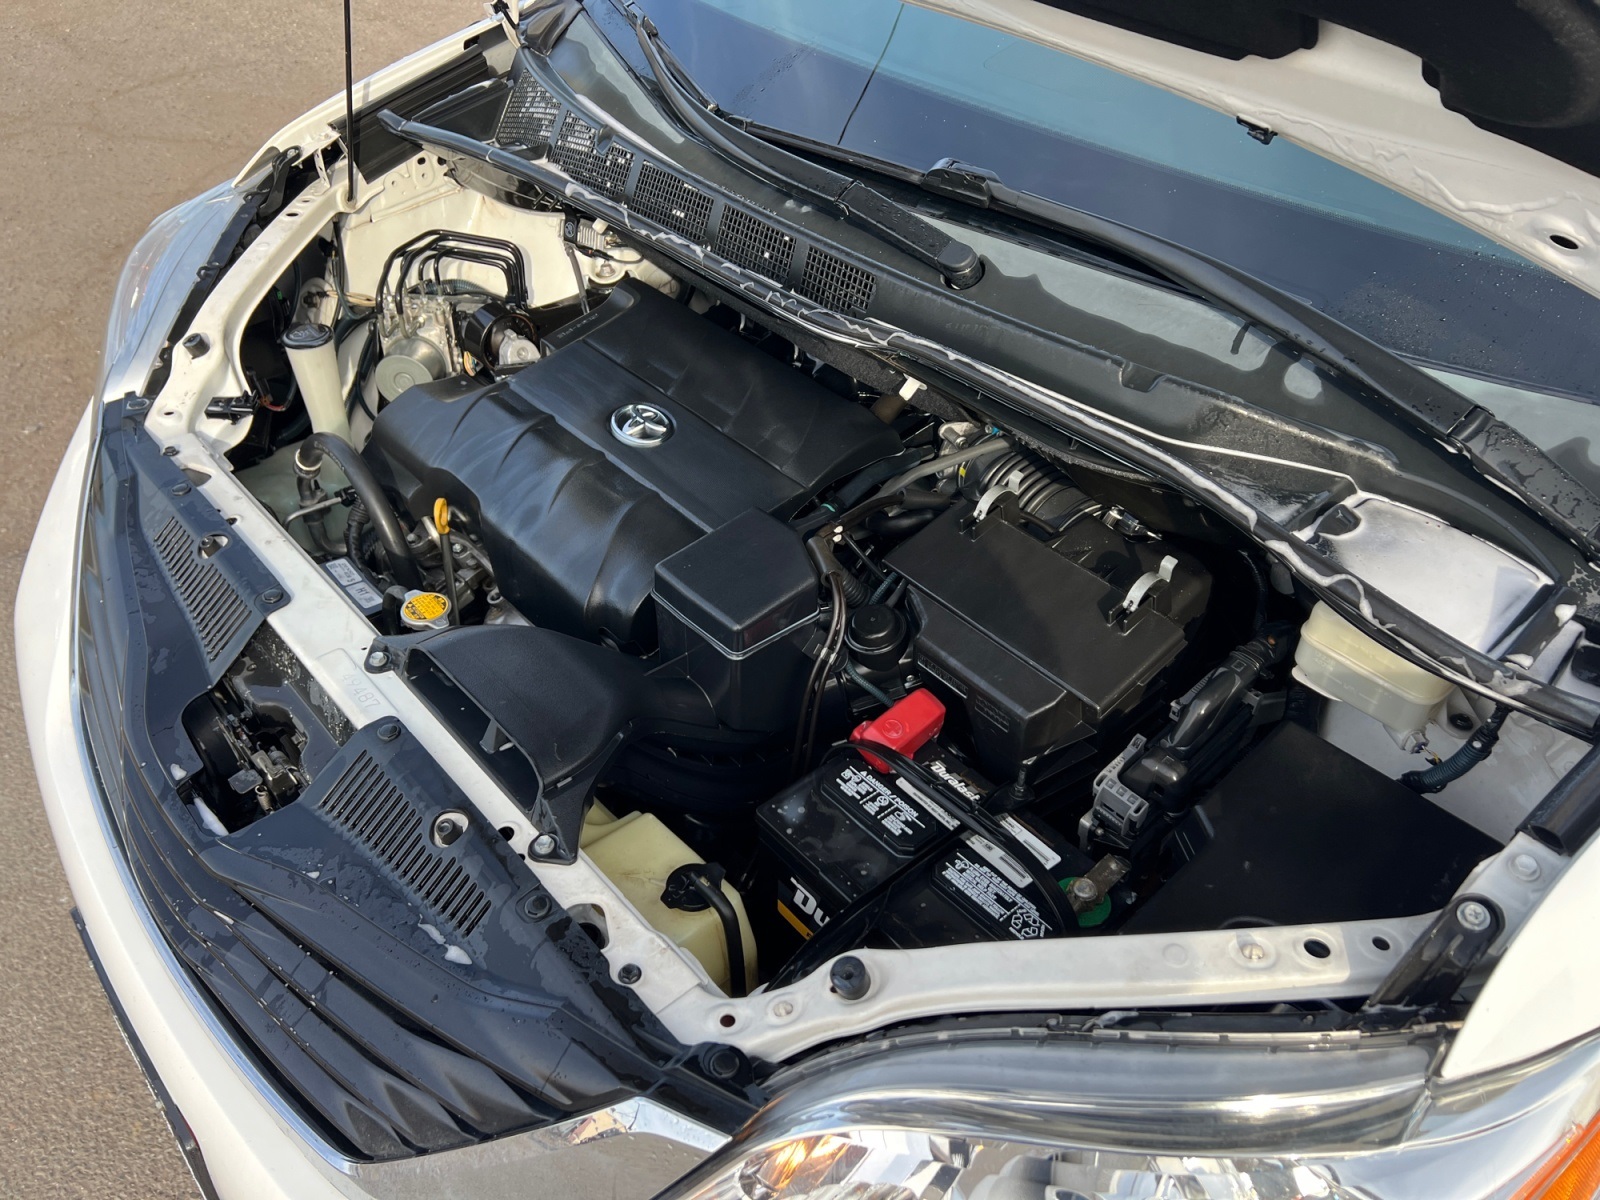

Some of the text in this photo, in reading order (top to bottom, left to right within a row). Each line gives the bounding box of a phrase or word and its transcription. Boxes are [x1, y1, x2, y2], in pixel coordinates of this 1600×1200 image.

[343, 673, 381, 708] 49487
[867, 775, 892, 796] DANGER
[894, 797, 919, 817] POISON
[931, 761, 981, 803] Duralast
